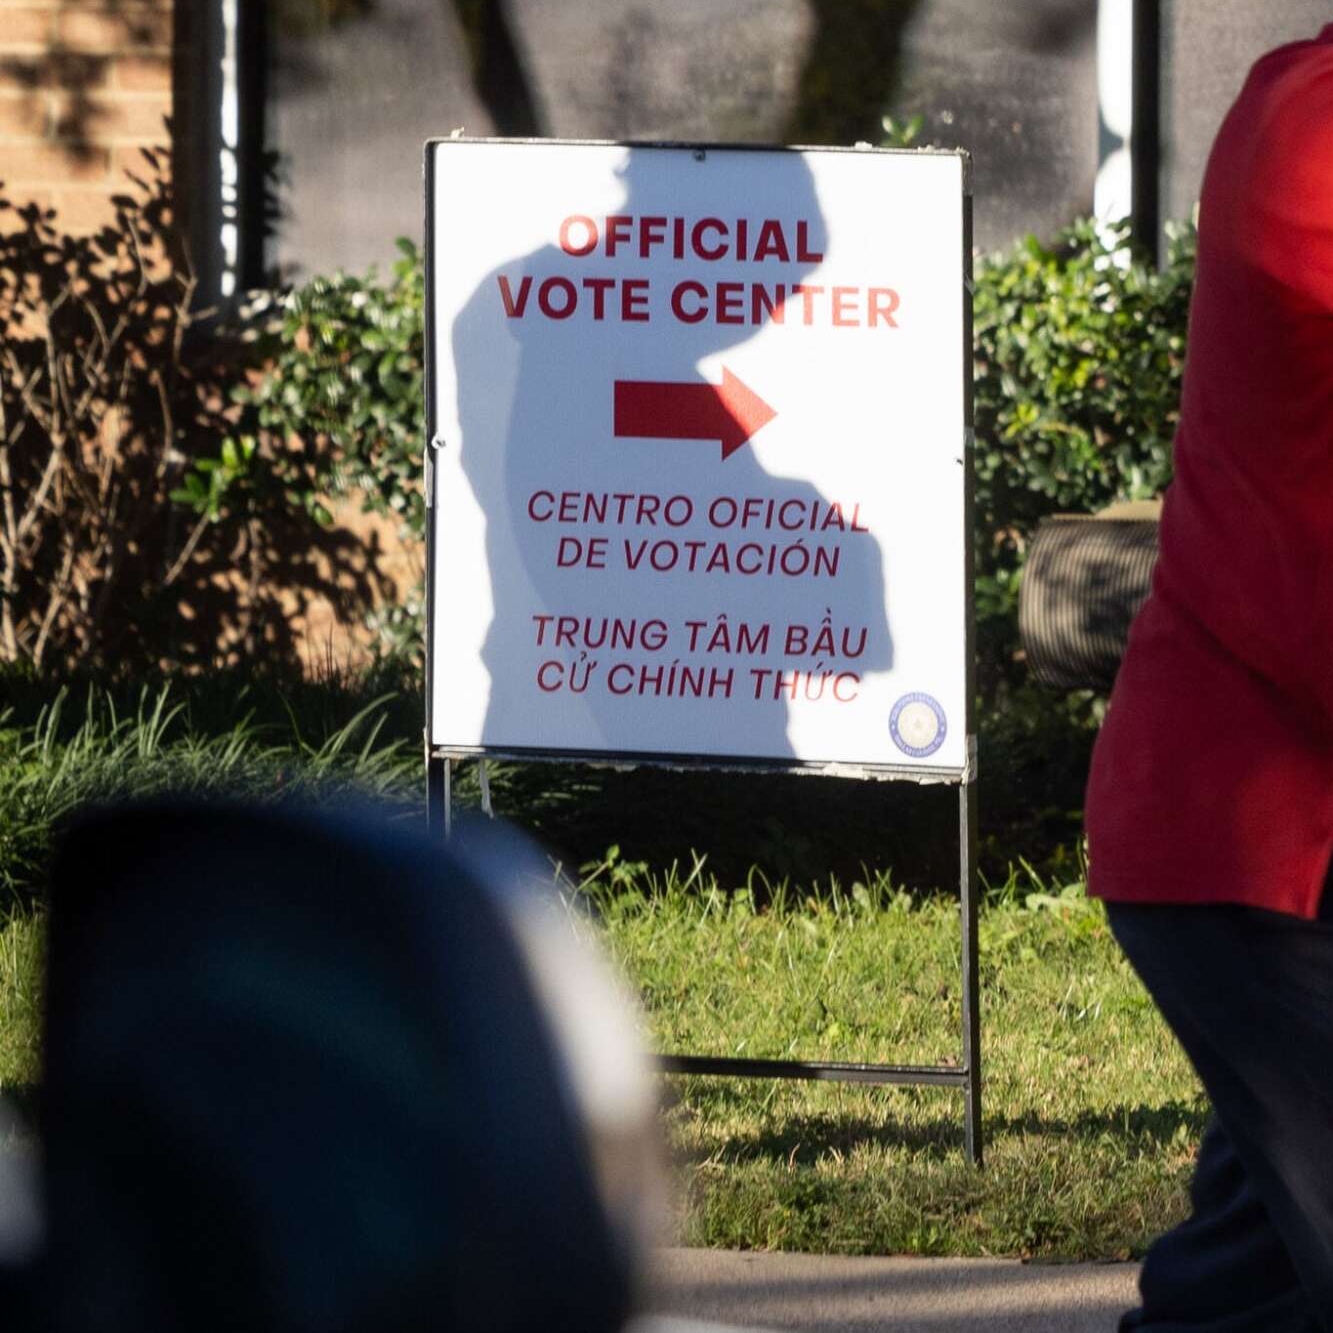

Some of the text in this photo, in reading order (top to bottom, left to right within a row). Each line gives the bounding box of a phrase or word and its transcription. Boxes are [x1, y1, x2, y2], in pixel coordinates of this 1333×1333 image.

[558, 213, 824, 264] OFFICIAL
[498, 275, 901, 330] VOTE CENTER
[527, 490, 870, 534] CENTRO OFICIAL
[556, 537, 840, 578] DE VOTACIÓN
[532, 607, 868, 659] TRUNG TÂM BẦU
[536, 649, 861, 703] CỬ CHÍNH THỨC
